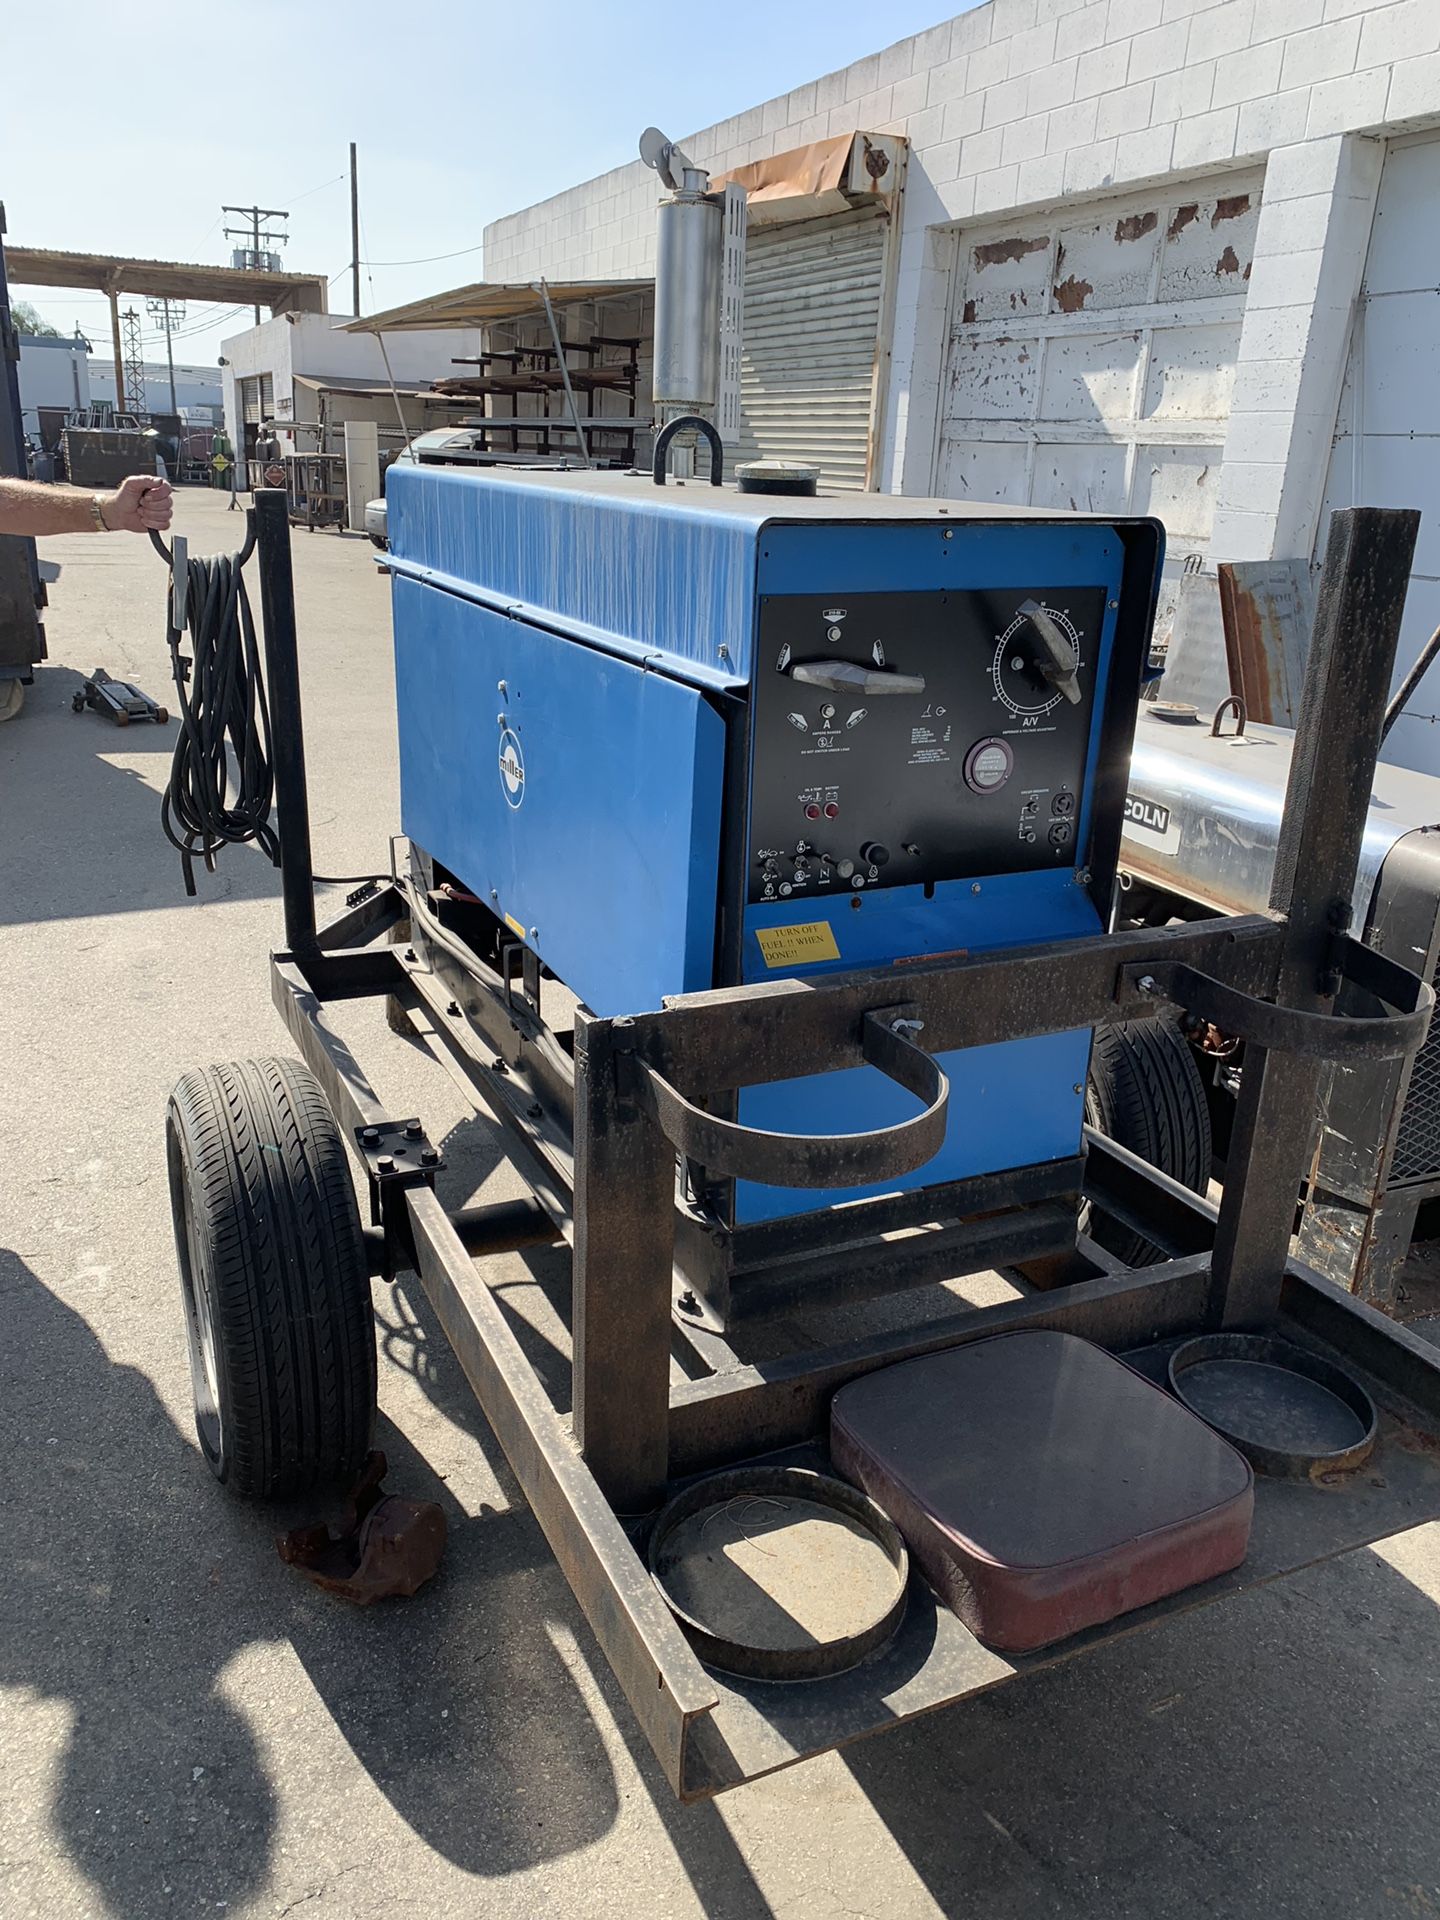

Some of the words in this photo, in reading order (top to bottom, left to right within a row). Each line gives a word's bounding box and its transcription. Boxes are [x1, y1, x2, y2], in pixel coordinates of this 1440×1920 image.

[823, 719, 831, 729] A
[1022, 717, 1038, 726] A/V
[774, 927, 801, 937] TURN
[801, 925, 817, 934] OFF
[760, 940, 786, 950] FUEL
[795, 936, 824, 945] WHEN
